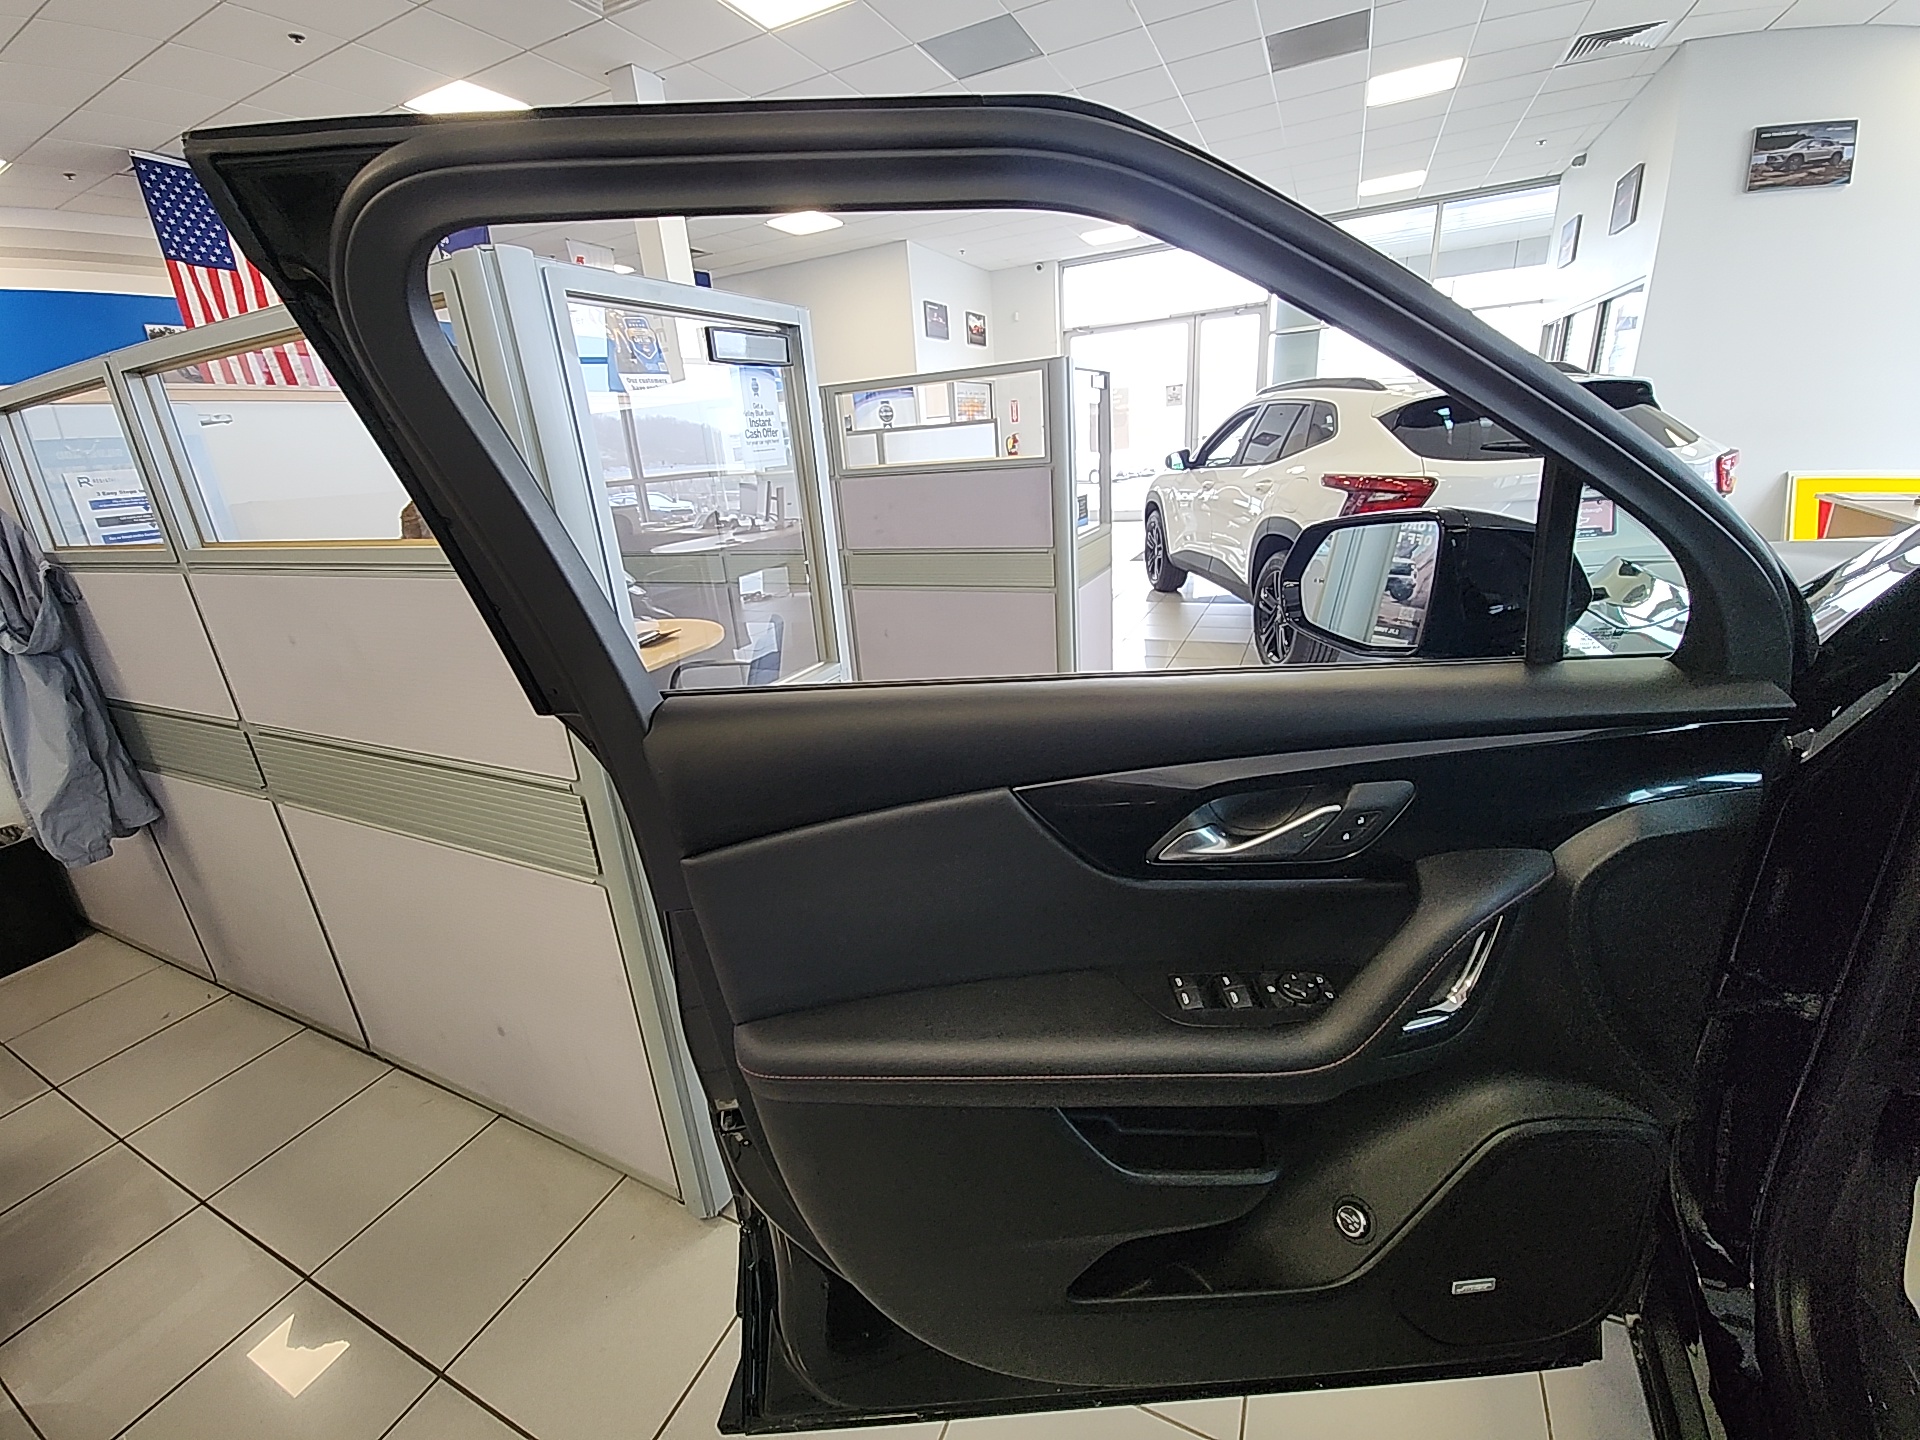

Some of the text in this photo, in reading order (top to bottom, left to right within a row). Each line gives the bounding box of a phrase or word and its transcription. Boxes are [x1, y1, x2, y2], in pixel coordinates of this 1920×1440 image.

[748, 417, 772, 427] Instant
[744, 427, 779, 439] Cash Offer
[76, 476, 94, 488] R
